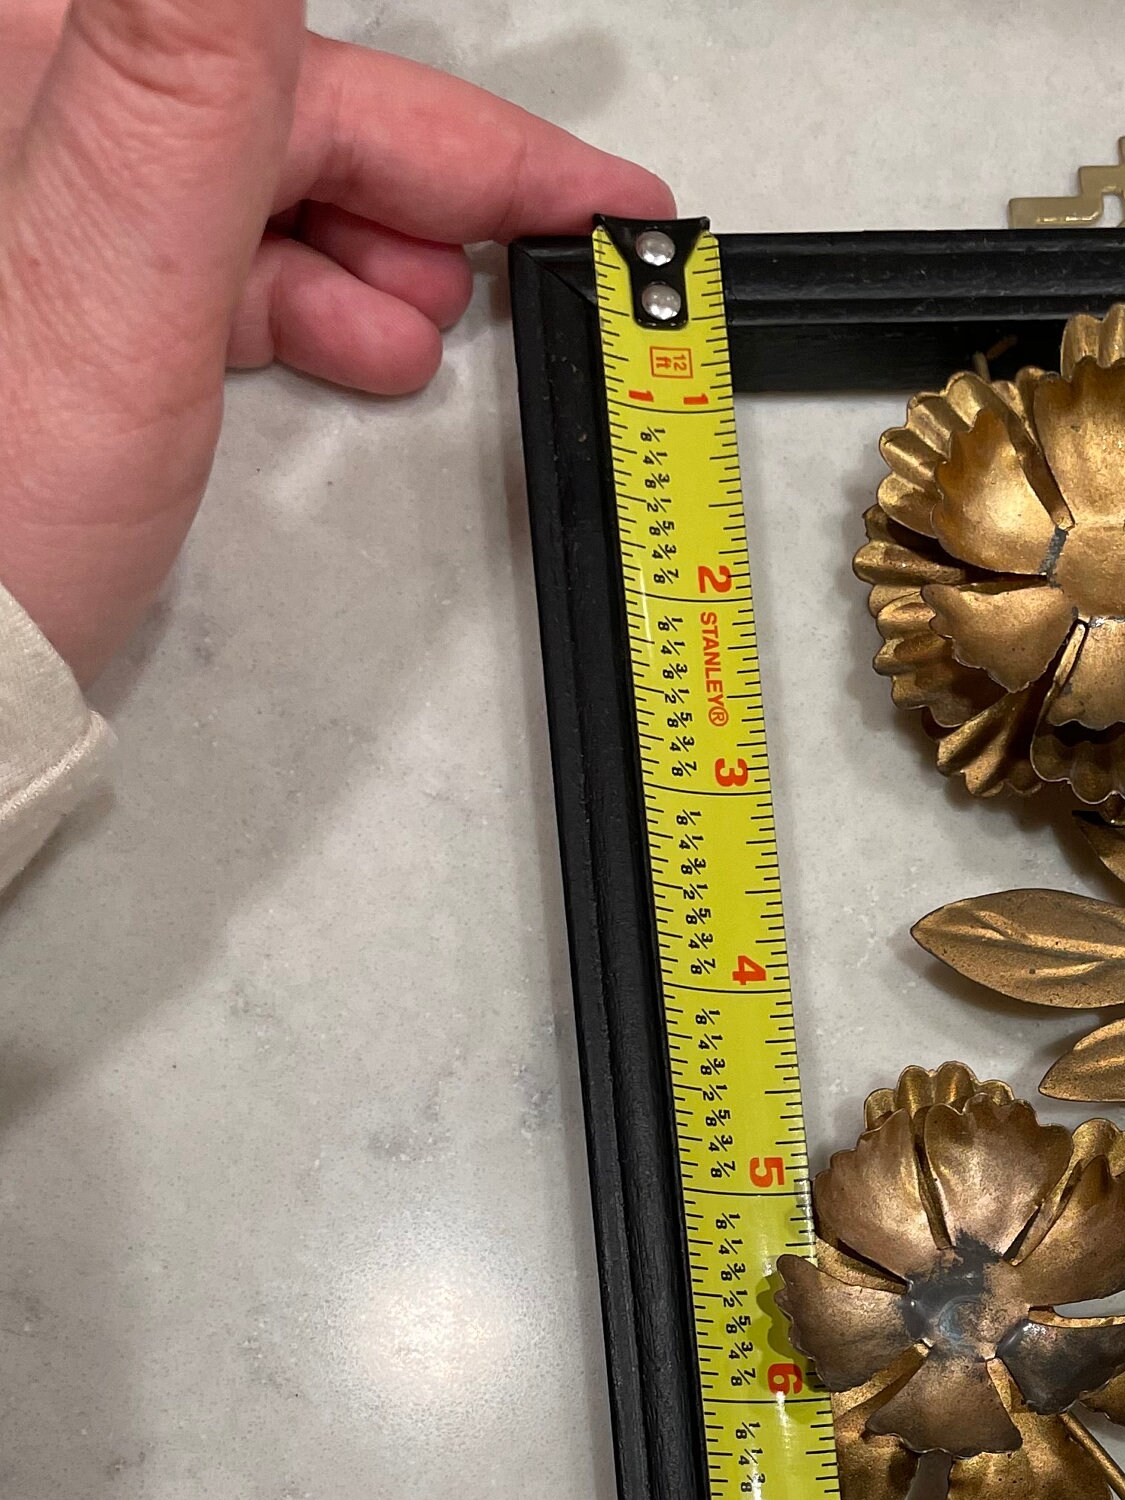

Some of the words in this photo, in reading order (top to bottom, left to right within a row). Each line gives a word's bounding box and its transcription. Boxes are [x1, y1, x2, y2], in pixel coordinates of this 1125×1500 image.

[673, 354, 687, 371] 12
[628, 389, 654, 402] 1
[683, 393, 709, 405] 1
[640, 426, 665, 442] 1/8
[643, 450, 667, 465] 1/4
[645, 473, 670, 489] 3/8
[647, 497, 671, 512] 1/2
[650, 520, 674, 536] 5/8
[652, 544, 676, 560] 3/4
[654, 568, 679, 584] 7/8
[698, 565, 732, 593] 2
[658, 615, 683, 631] 1/8
[661, 640, 685, 655] 1/4
[663, 663, 688, 680] 3/8
[665, 688, 690, 704] 1/2
[667, 711, 692, 728] 5/8
[669, 736, 695, 752] 3/4
[672, 760, 697, 777] 7/8
[715, 758, 749, 787] 3
[676, 809, 701, 826] 1/8
[679, 834, 704, 850] 1/4
[681, 858, 706, 875] 3/8
[683, 883, 708, 900] 1/2
[686, 907, 711, 925] 5/8
[688, 933, 713, 949] 3/4
[691, 958, 716, 975] 7/8
[732, 955, 767, 985] 4
[695, 1008, 720, 1025] 1/8
[698, 1034, 723, 1050] 1/4
[700, 1058, 725, 1076] 3/8
[703, 1084, 728, 1101] 1/2
[705, 1109, 731, 1127] 5/8
[708, 1134, 733, 1152] 3/4
[710, 1160, 736, 1178] 7/8
[750, 1157, 785, 1187] 5
[715, 1213, 741, 1230] 1/8
[718, 1238, 743, 1255] 1/4
[720, 1263, 745, 1281] 3/8
[723, 1290, 748, 1308] 1/2
[725, 1315, 751, 1333] 5/8
[728, 1341, 753, 1359] 3/4
[730, 1368, 756, 1386] 7/8
[767, 1363, 803, 1395] 6
[735, 1422, 761, 1440] 1/8
[738, 1448, 763, 1466] 1/4
